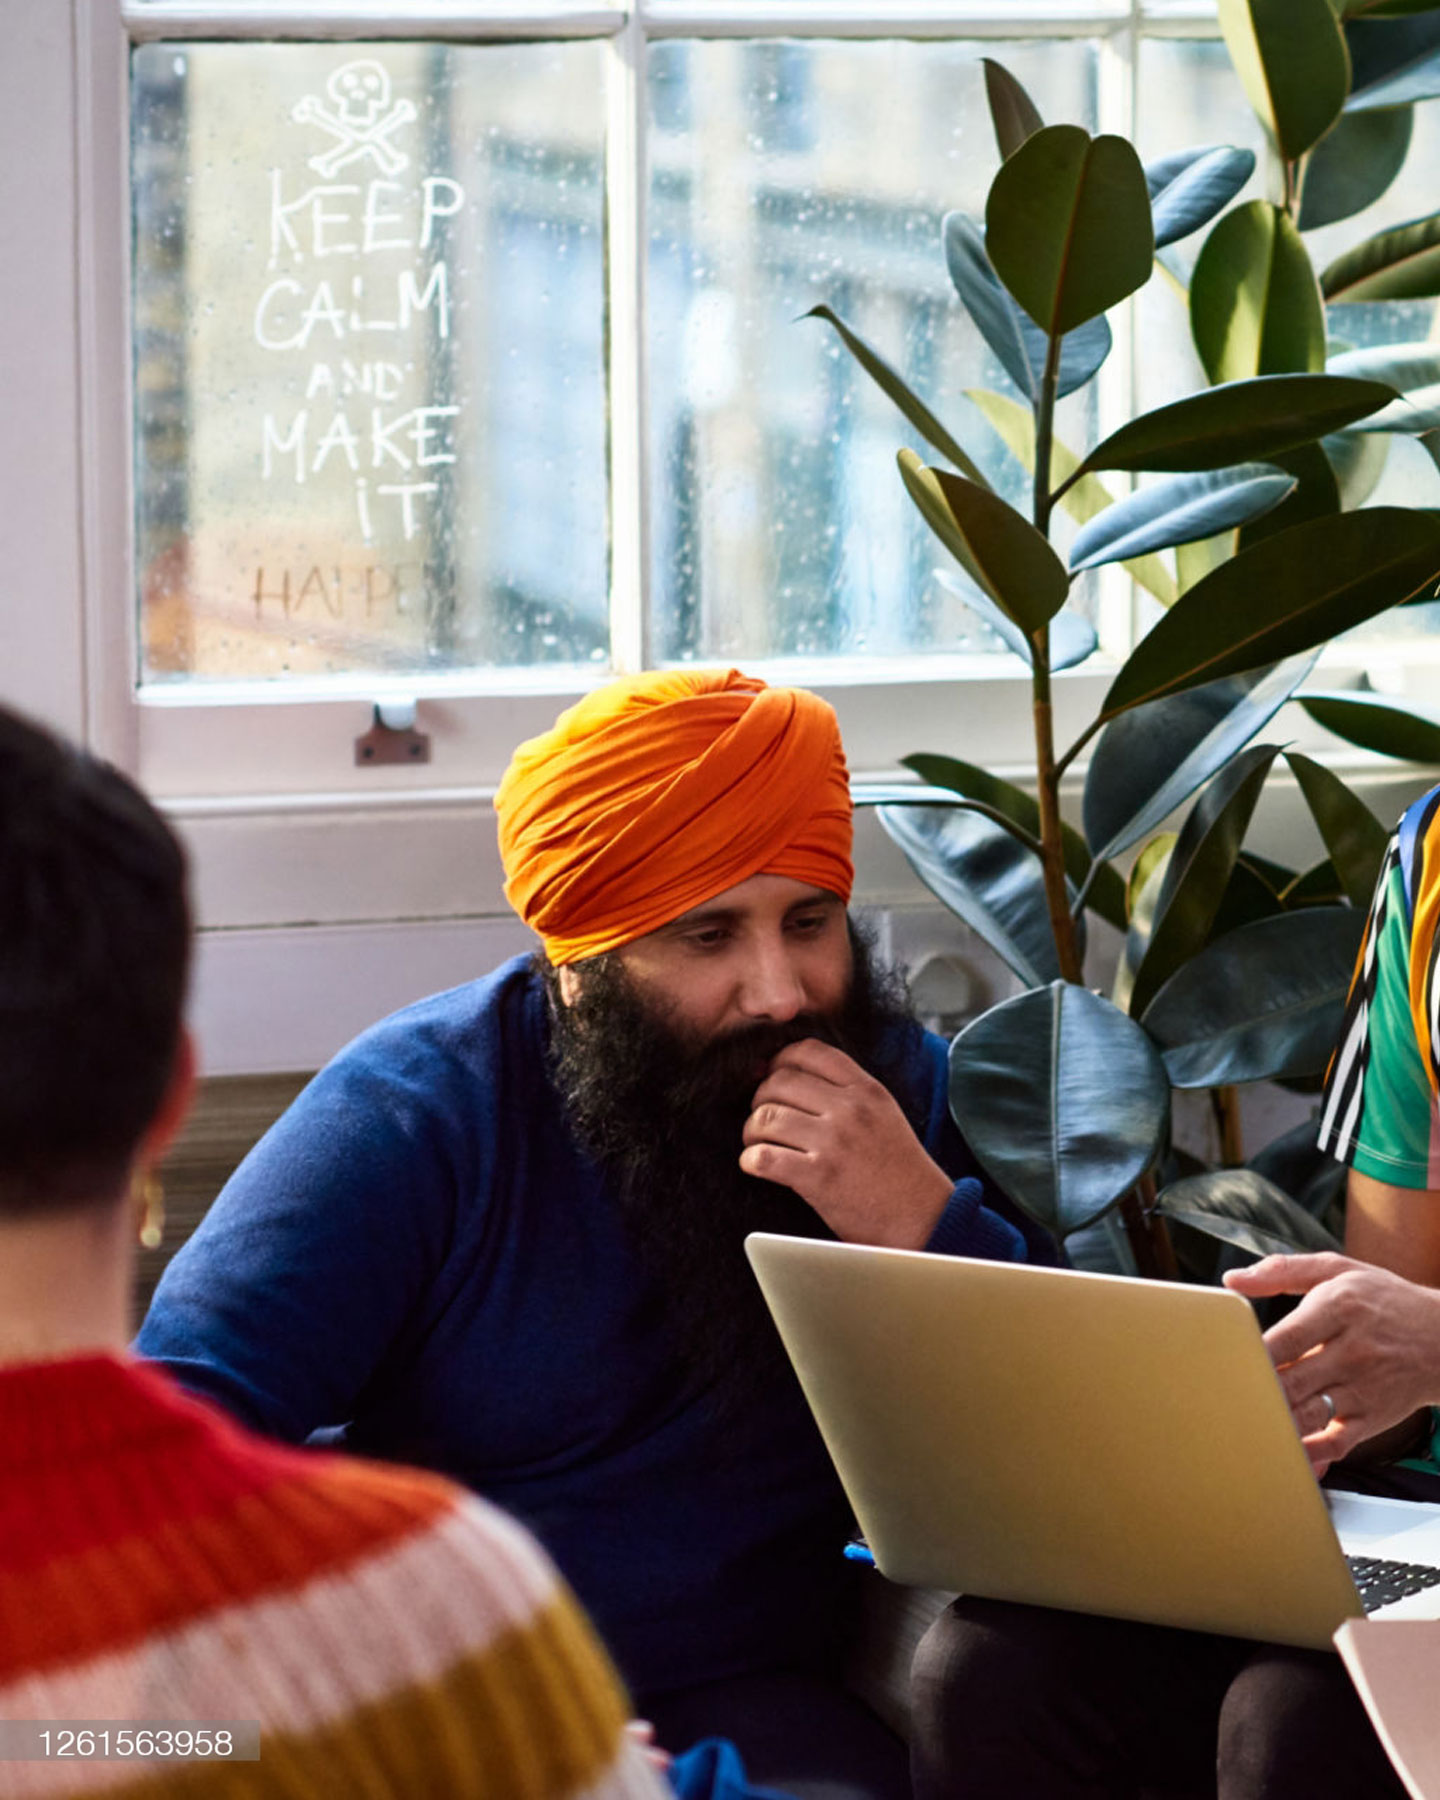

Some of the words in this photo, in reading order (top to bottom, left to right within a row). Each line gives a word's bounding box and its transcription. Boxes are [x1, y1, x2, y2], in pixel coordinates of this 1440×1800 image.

[266, 168, 464, 270] KEEP
[254, 262, 449, 349] CALM
[307, 361, 405, 399] AND
[262, 405, 461, 483] MAKE
[357, 478, 438, 542] IT
